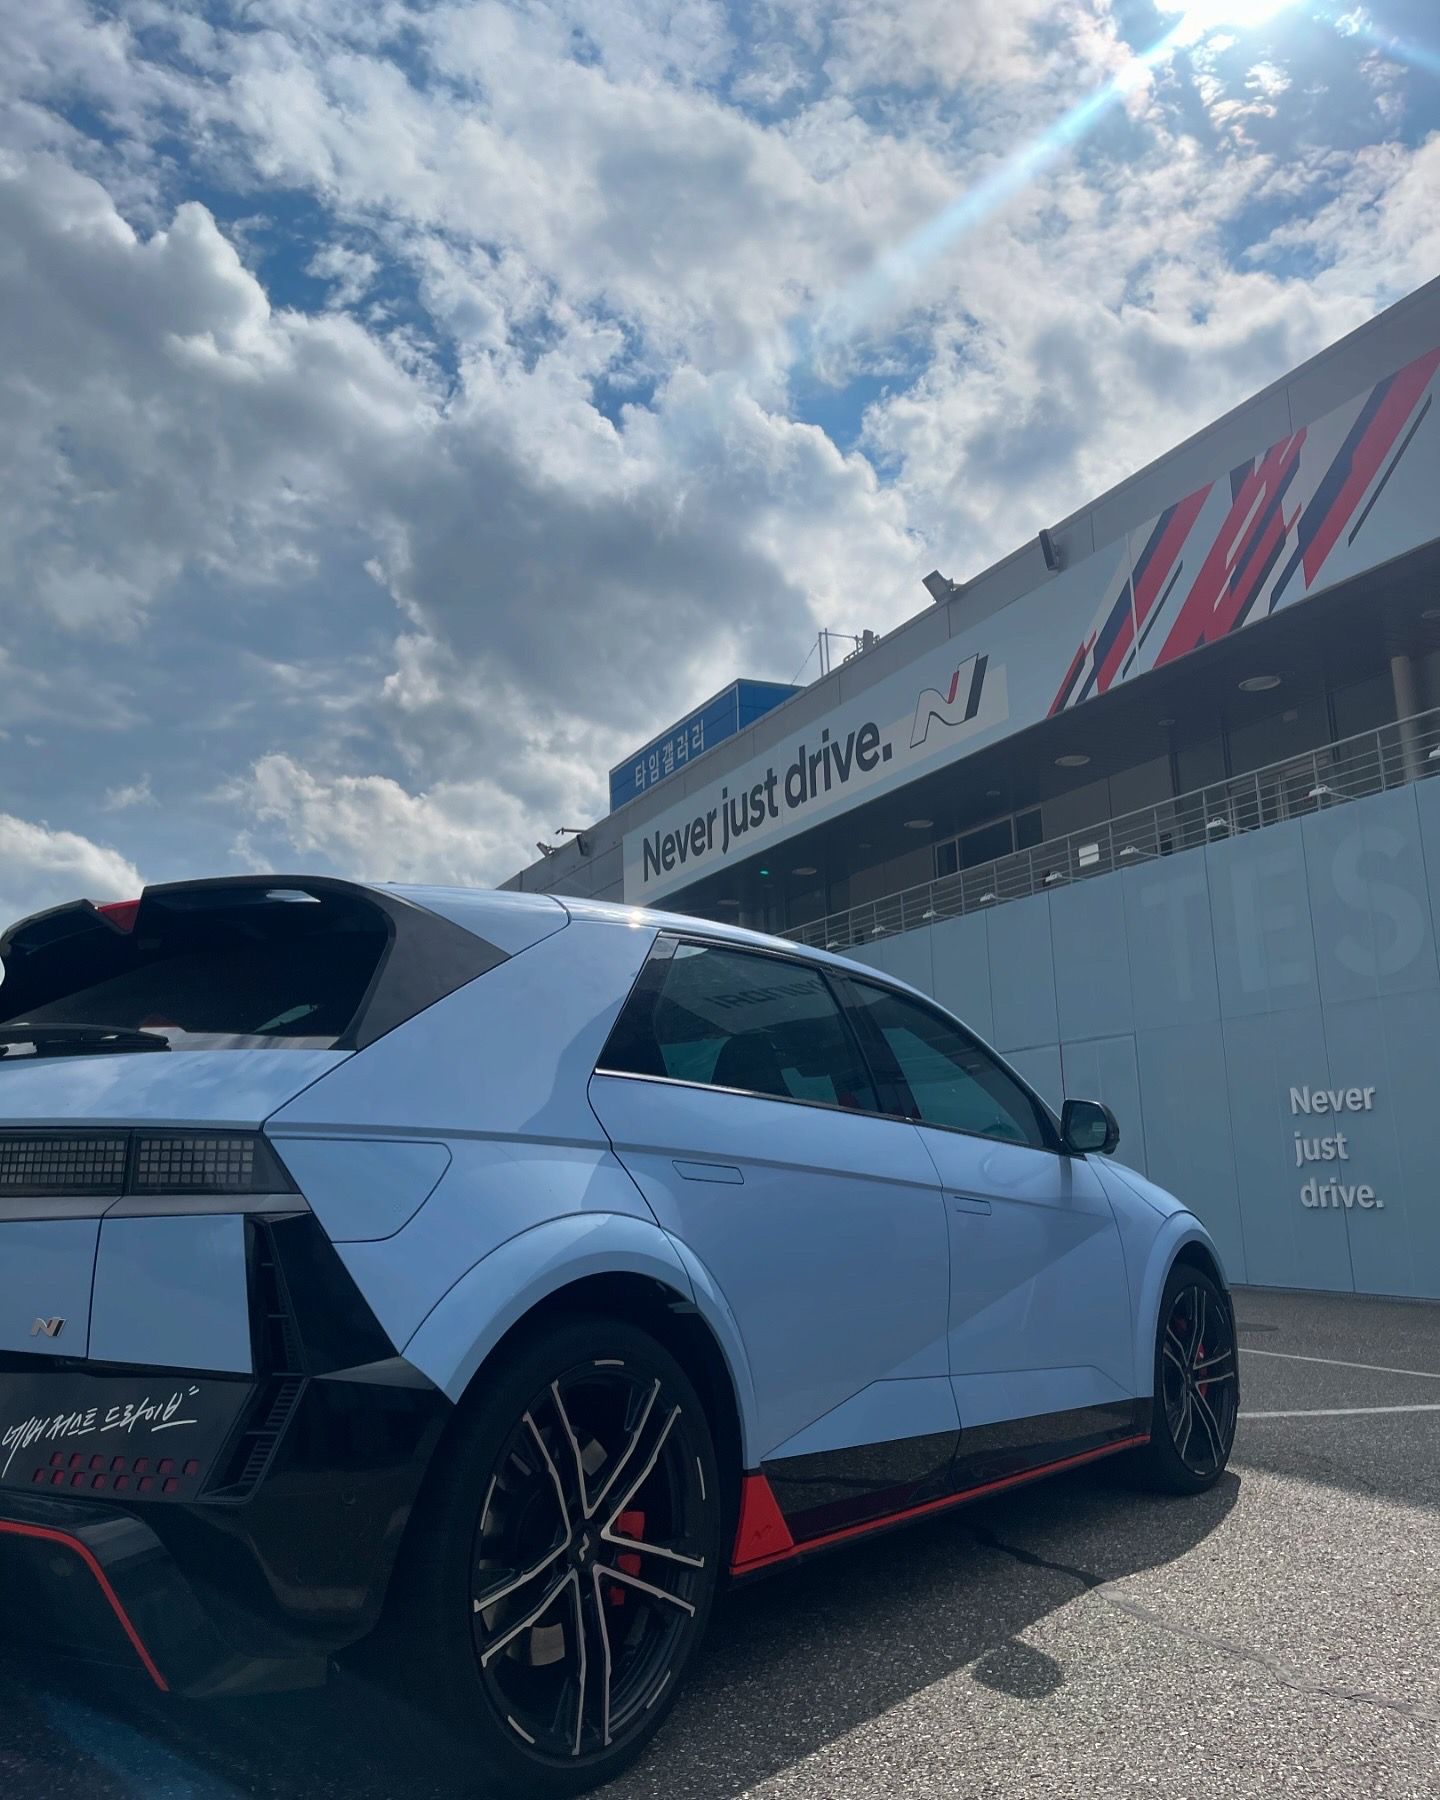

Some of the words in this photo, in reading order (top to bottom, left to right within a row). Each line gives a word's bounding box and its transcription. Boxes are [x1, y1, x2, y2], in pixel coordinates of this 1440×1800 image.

[643, 808, 717, 882] Never
[722, 767, 779, 855] just
[784, 722, 893, 809] drive.
[1289, 1085, 1376, 1115] Never
[1294, 1130, 1349, 1168] just
[1300, 1177, 1385, 1209] drive.
[1, 1416, 51, 1479] 네버
[45, 1408, 98, 1440] 저스트
